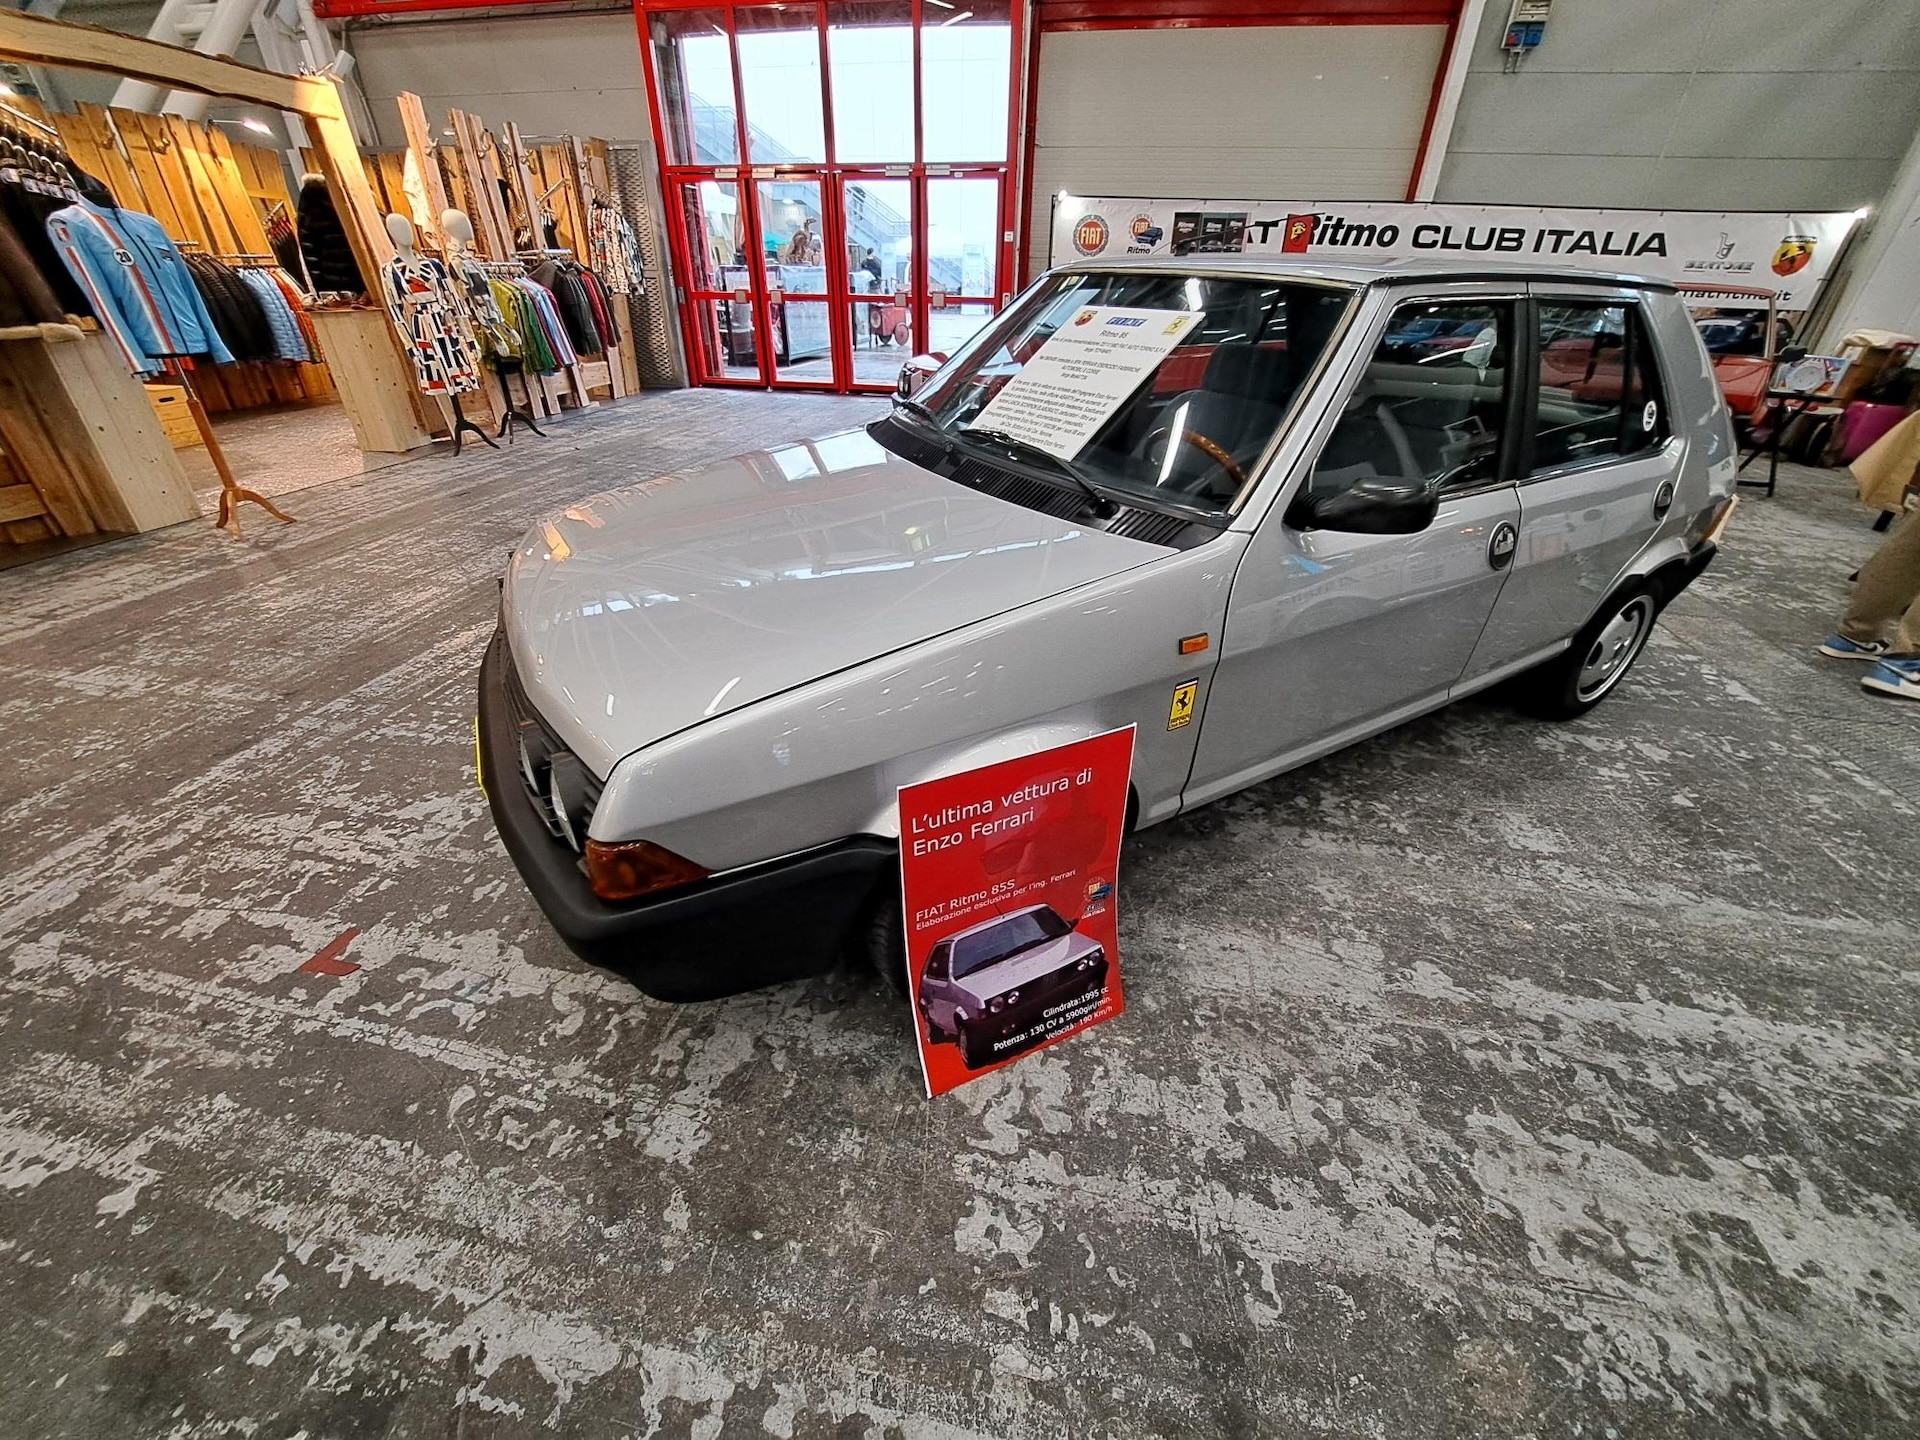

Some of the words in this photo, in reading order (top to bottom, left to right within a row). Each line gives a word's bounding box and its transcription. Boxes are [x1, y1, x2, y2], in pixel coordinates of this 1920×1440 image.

[1081, 227, 1102, 245] FIAT
[1126, 246, 1151, 255] Ritmo
[1412, 224, 1525, 252] CLUB
[1532, 229, 1668, 258] ITALIA
[115, 251, 133, 263] 20
[911, 798, 993, 834] L'ultima
[1001, 775, 1070, 808] vettura
[1075, 767, 1093, 786] di
[913, 830, 964, 857] Enzo
[970, 806, 1035, 840] Ferrari
[916, 905, 972, 931] Elaborazione
[973, 892, 1011, 910] esclusiva
[1012, 886, 1028, 899] per
[1028, 879, 1048, 894] l'ing.
[1050, 869, 1077, 884] Ferrari
[916, 902, 946, 922] FIAT
[950, 889, 987, 910] Ritmo
[991, 879, 1016, 896] 85S
[1100, 986, 1109, 994] cc
[1079, 1014, 1093, 1026] 190
[1094, 1005, 1113, 1019] Km/h
[993, 1031, 1028, 1051] Potenza:
[1030, 1023, 1045, 1036] 130
[1046, 1018, 1057, 1029] CV
